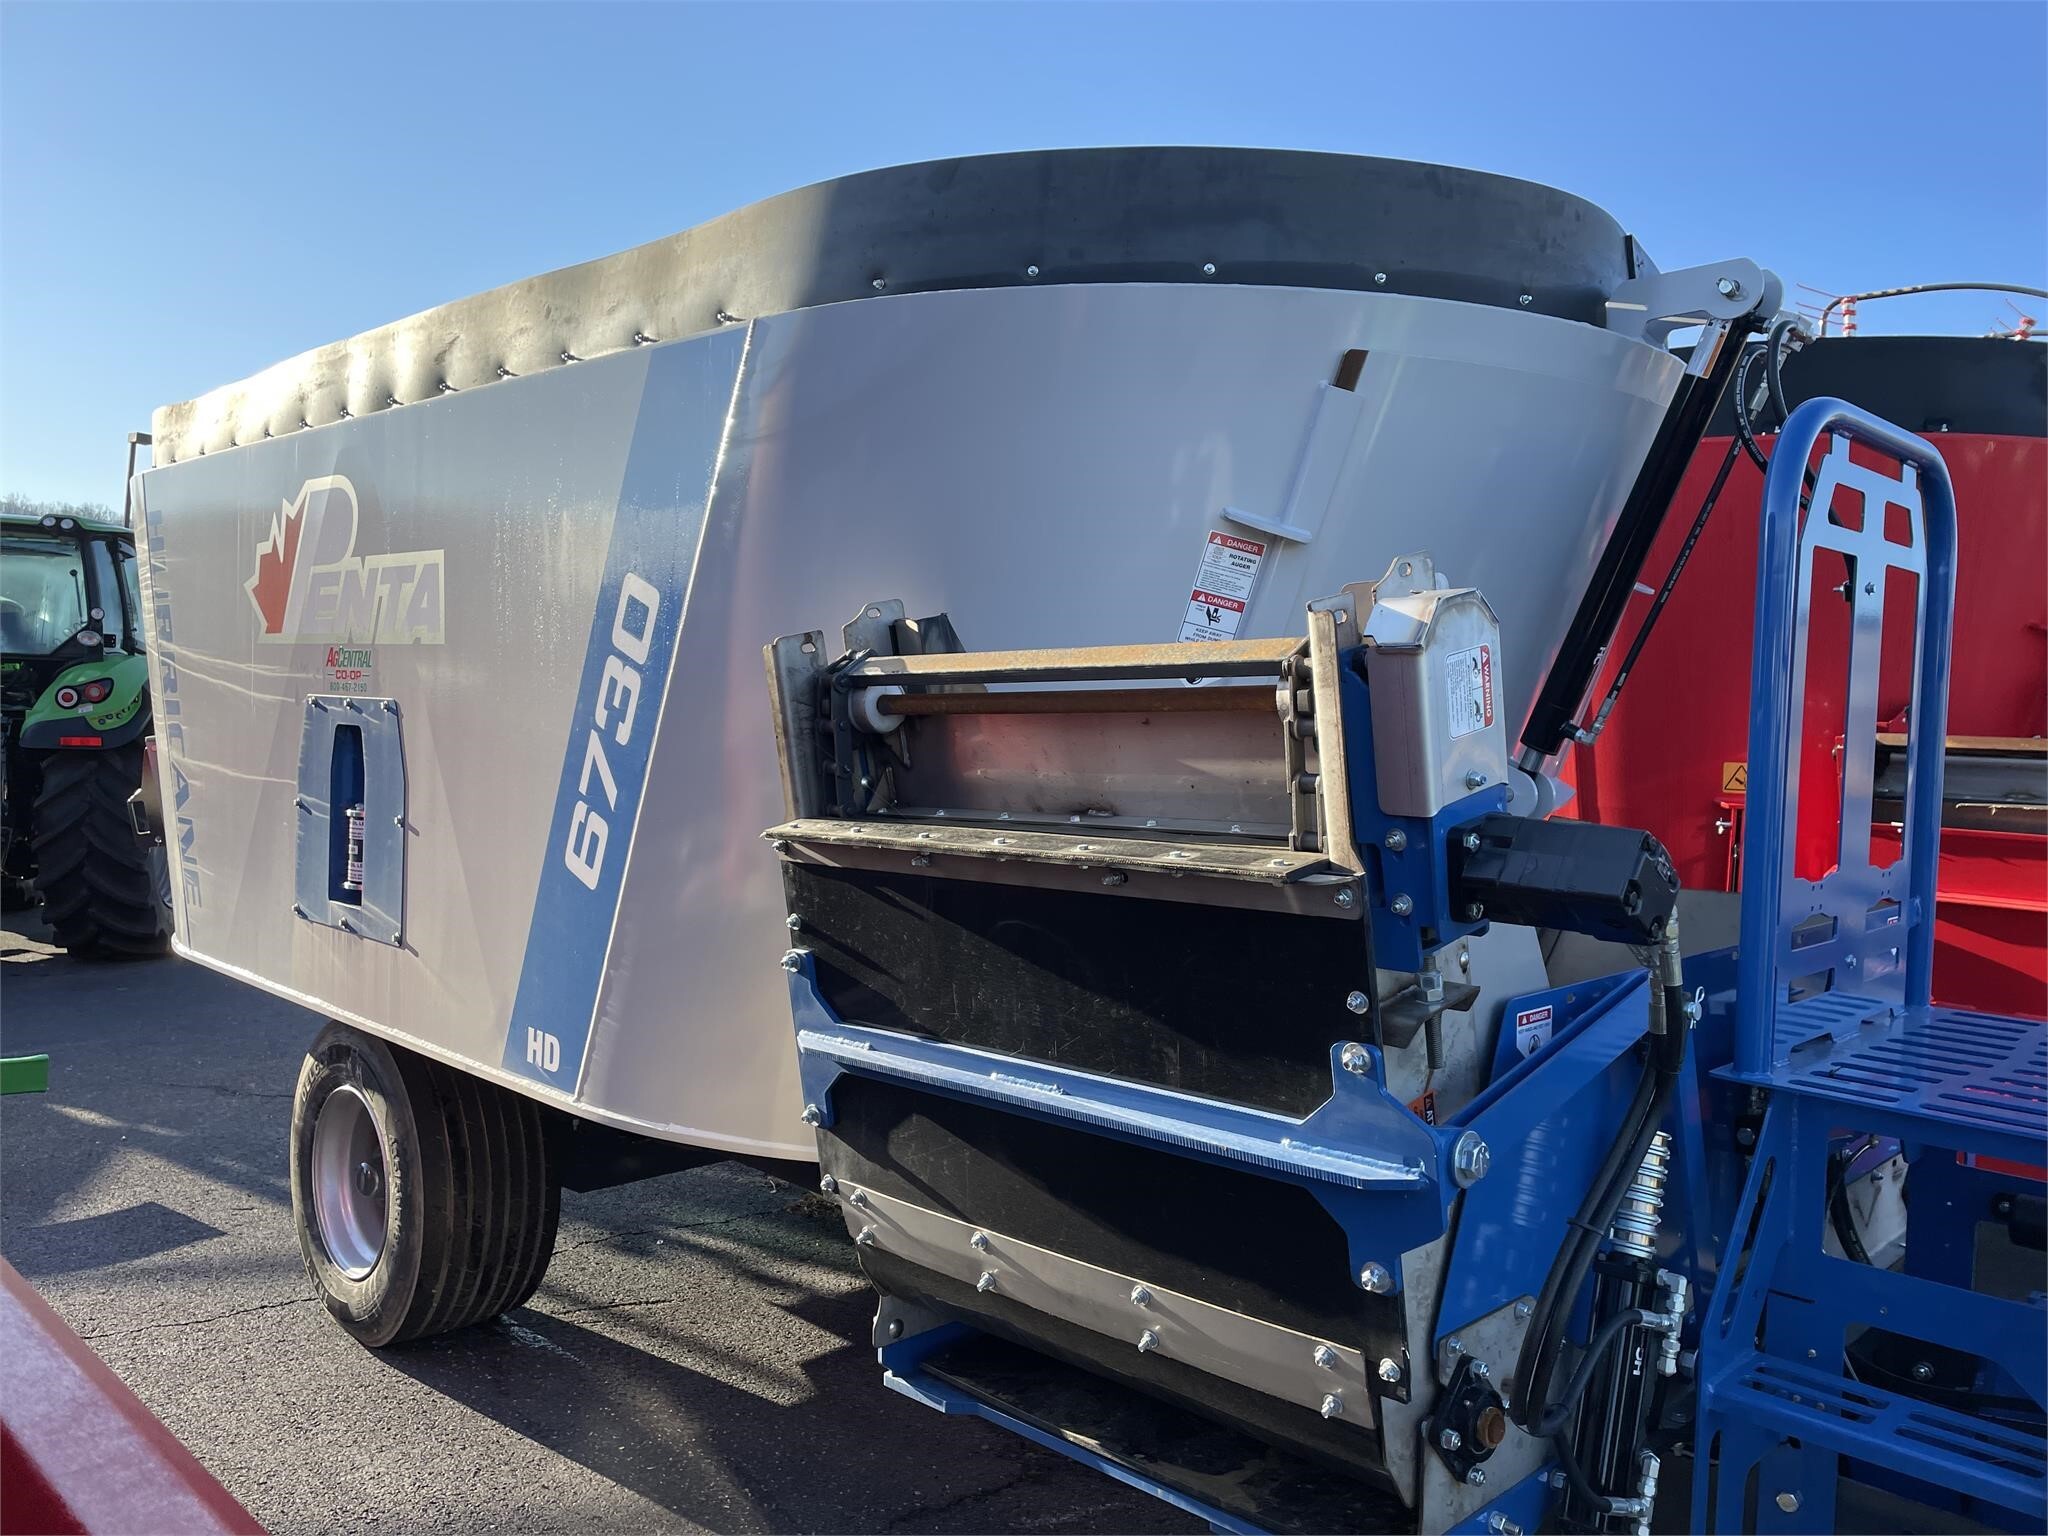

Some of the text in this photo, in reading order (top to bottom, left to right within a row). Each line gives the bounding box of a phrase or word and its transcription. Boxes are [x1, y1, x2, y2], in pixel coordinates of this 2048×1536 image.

[1227, 539, 1259, 553] DANGER
[283, 475, 444, 644] PENTA
[1229, 553, 1257, 565] ROTATING
[1230, 560, 1251, 570] AUGER
[1207, 595, 1239, 609] DANGER
[1192, 632, 1207, 640] FROM
[335, 669, 362, 680] CO-OP
[1484, 664, 1492, 717] WARNING
[564, 572, 661, 891] 6730
[1529, 1010, 1549, 1023] DANGER
[527, 1026, 560, 1073] HD
